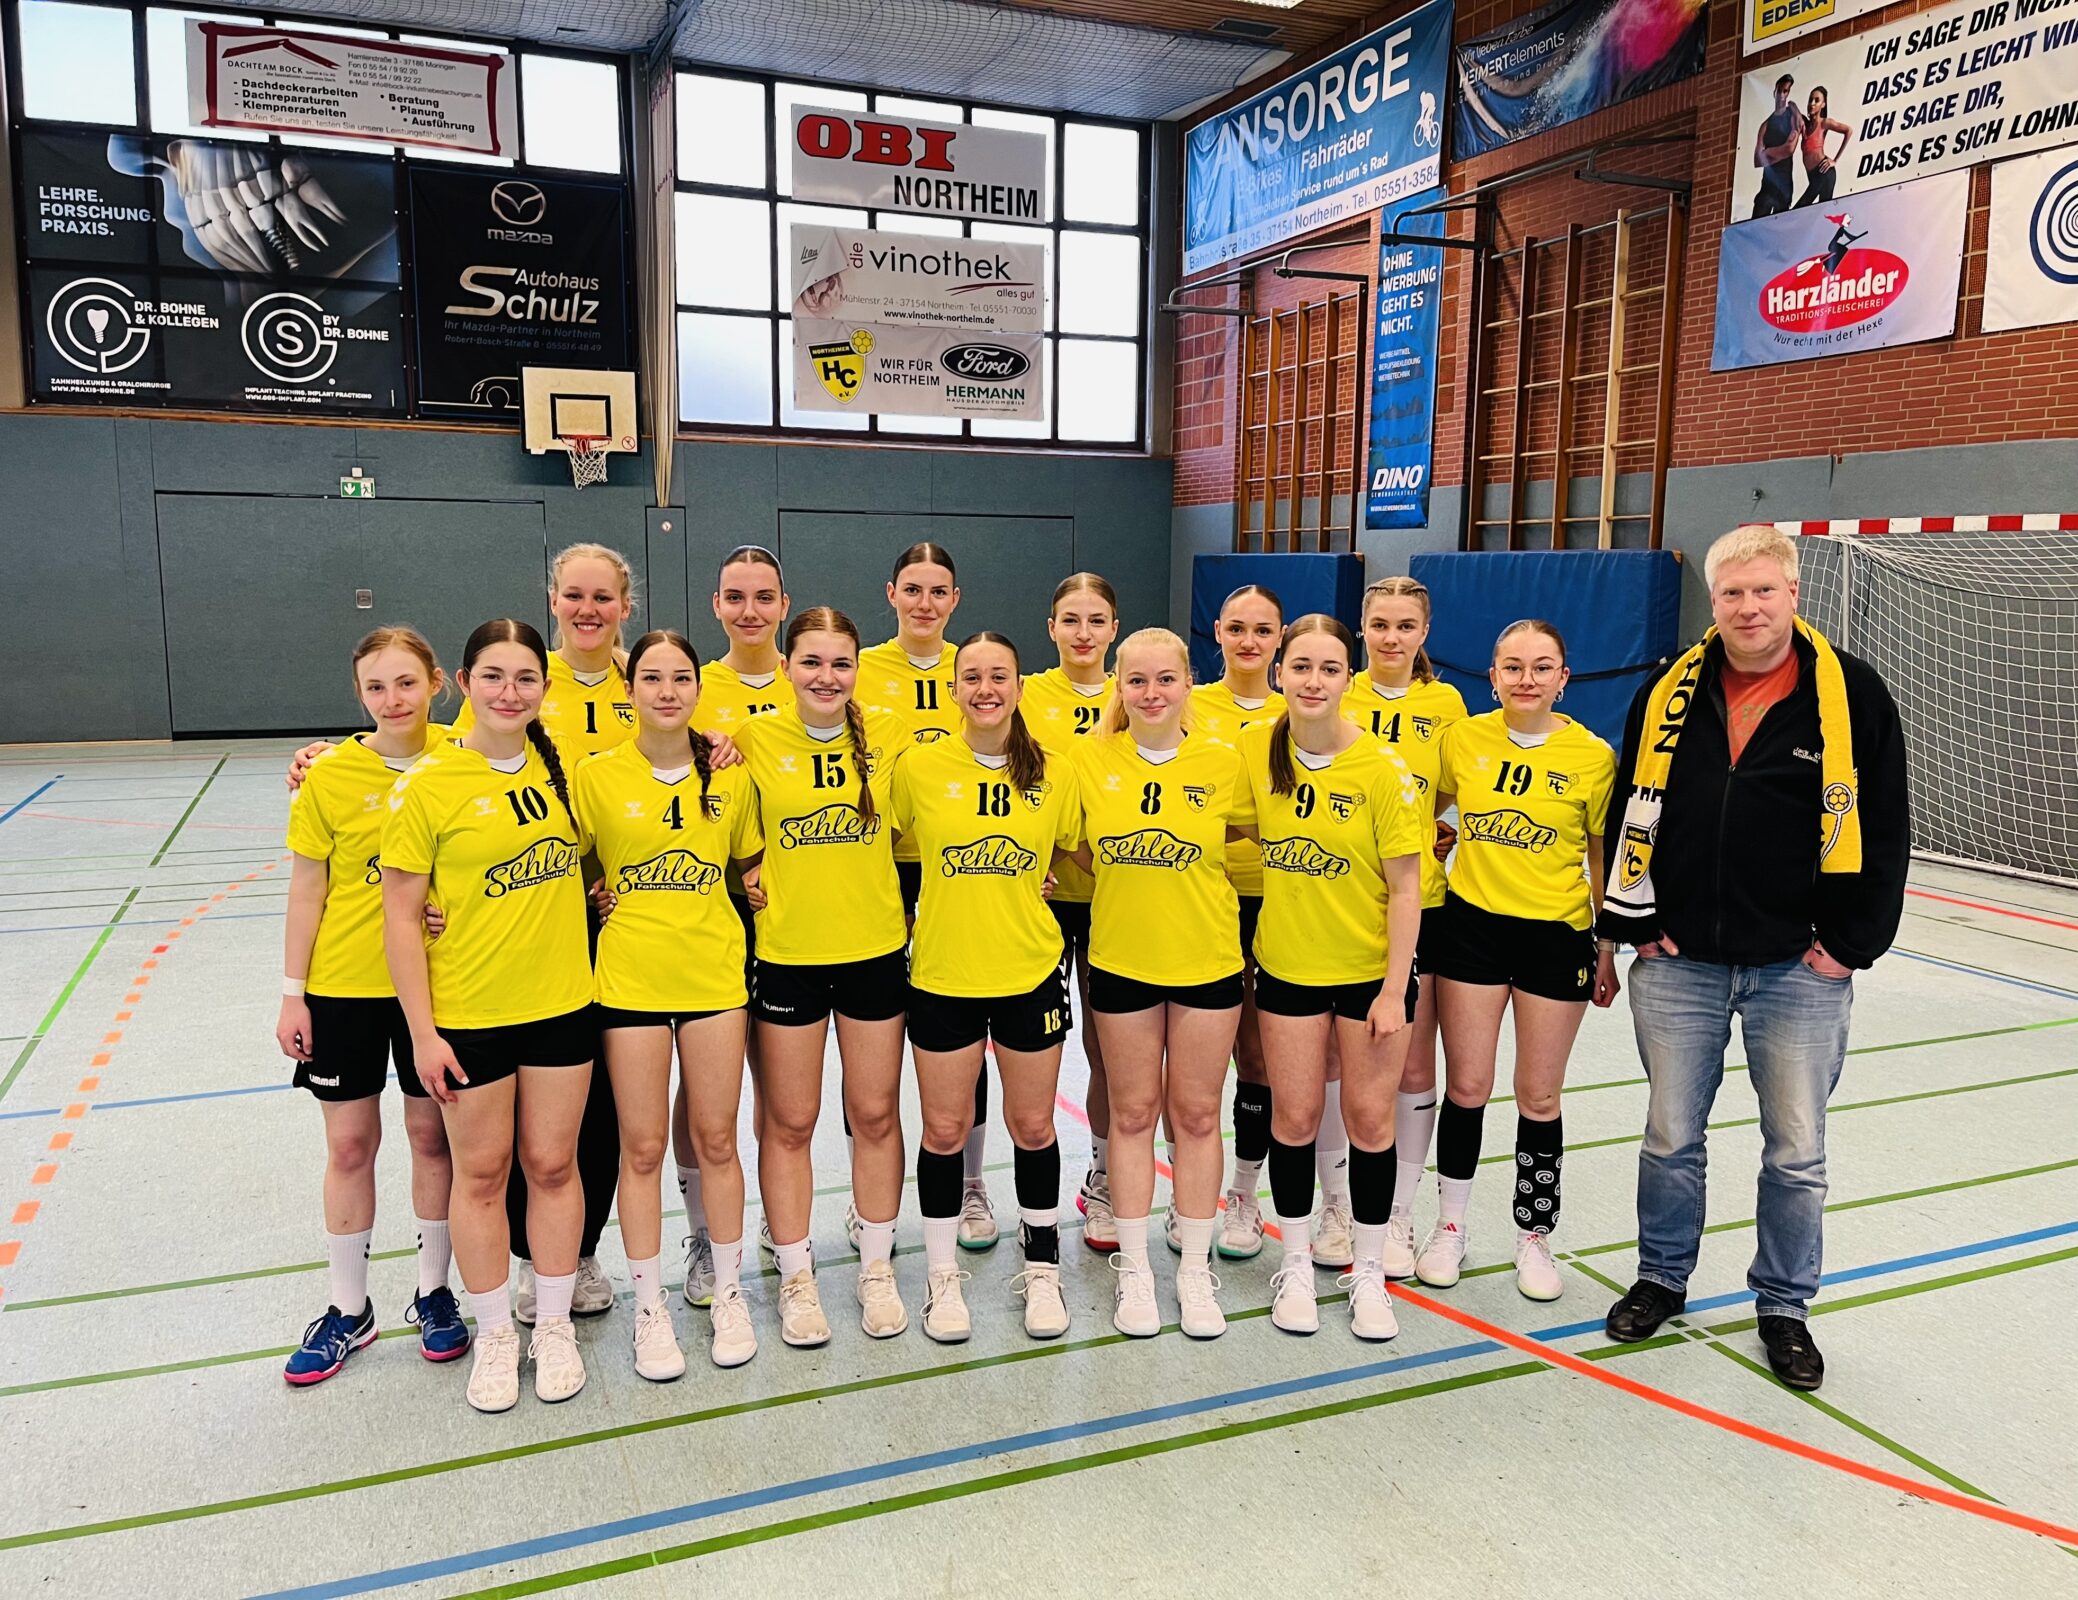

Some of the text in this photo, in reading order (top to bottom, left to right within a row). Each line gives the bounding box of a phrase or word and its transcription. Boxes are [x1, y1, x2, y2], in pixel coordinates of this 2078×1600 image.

[1762, 0, 1828, 27] EDEKA
[1864, 1, 2010, 69] ICH SAGE DIR
[227, 60, 303, 75] DACHTEAM BOCK
[1862, 30, 2038, 106] DASS ES LEICHT
[241, 78, 358, 98] Dachdeckerarbeiten
[242, 89, 340, 107] Dachreparaturen
[1216, 27, 1412, 171] ANSORGE
[243, 100, 347, 118] Klempnerarbeiten
[388, 93, 440, 108] Beratung
[1859, 80, 2005, 142] ICH SAGE DIR,
[244, 112, 267, 121] Rufen
[270, 114, 283, 123] Sie
[342, 121, 356, 129] Sie
[357, 125, 384, 133] unsere
[400, 105, 445, 119] Planung
[411, 116, 475, 133] Ausführung
[797, 114, 957, 172] OBI
[1301, 127, 1374, 173] Fahrräder
[1856, 144, 1912, 178] DASS
[1918, 133, 1948, 164] ES
[1952, 117, 2004, 157] SICH
[1290, 151, 1389, 202] Service rund Rad
[39, 186, 103, 202] LEHRE.
[894, 175, 1038, 219] NORTHEIM
[1295, 203, 1343, 230] Northeim
[1352, 190, 1371, 210] Tel.
[1374, 162, 1439, 202] 05551-3584
[40, 202, 157, 222] FORSCHUNG.
[41, 219, 115, 236] PRAXIS.
[487, 228, 553, 245] mazda
[849, 242, 864, 269] die
[869, 245, 1012, 281] vinothek
[1383, 250, 1413, 273] OHNE
[515, 269, 600, 290] Autohaus
[1382, 265, 1436, 294] WERBUNG
[444, 265, 600, 324] Schulz
[996, 288, 1035, 301] alles gut
[1767, 267, 1899, 315] Harzländer
[134, 301, 206, 316] DR. BOHNE
[883, 297, 894, 305] 24
[899, 298, 926, 308] 37154
[927, 300, 964, 311] Northeim
[983, 304, 1037, 315] 05551-70030
[1382, 290, 1424, 315] GEHT ES
[1775, 298, 1884, 324] TRADITIONS-FLEISCHEREI
[135, 314, 220, 329] & KOLLEGEN
[323, 314, 340, 326] BY
[884, 310, 995, 324] www.vinothek-northeim.de
[1380, 316, 1414, 336] NICHT.
[323, 327, 390, 341] DR. BOHNE
[444, 319, 601, 339] Ihr Mazda-Partner in Northeim
[1774, 316, 1883, 347] Nur echt mit der Hexe
[444, 335, 530, 348] Robert-Bosch-Straße
[880, 358, 933, 372] WIR FÜR
[957, 348, 1015, 375] Ford
[51, 378, 110, 387] ZAHNHEILKUNDE
[822, 360, 858, 389] HC
[873, 373, 940, 386] NORTHEIM
[51, 385, 136, 395] WWW.PRAXIS-BOHNE.DE
[245, 387, 272, 395] IMPLANT
[307, 390, 334, 398] IMPLANT
[946, 385, 1025, 400] HERMANN
[1371, 464, 1424, 490] DINO
[914, 679, 939, 710] 11
[584, 701, 598, 734] 1
[1074, 706, 1100, 735] 21
[1371, 710, 1401, 743] 14
[812, 753, 847, 789] 15
[1493, 761, 1533, 797] 19
[505, 786, 549, 826] 10
[976, 782, 1011, 817] 18
[1140, 781, 1161, 815] 8
[1296, 783, 1316, 819] 9
[662, 795, 684, 830] 4
[801, 836, 857, 844] Fahrschule
[1475, 833, 1525, 848] Fahrschule
[961, 866, 1014, 876] Fahrschule
[1117, 857, 1170, 867] Fahrschule
[1624, 844, 1643, 877] HC
[637, 882, 693, 891] Fahrschule
[1577, 967, 1588, 987] 9
[1044, 1008, 1061, 1035] 18
[1241, 1101, 1262, 1112] SELECT
